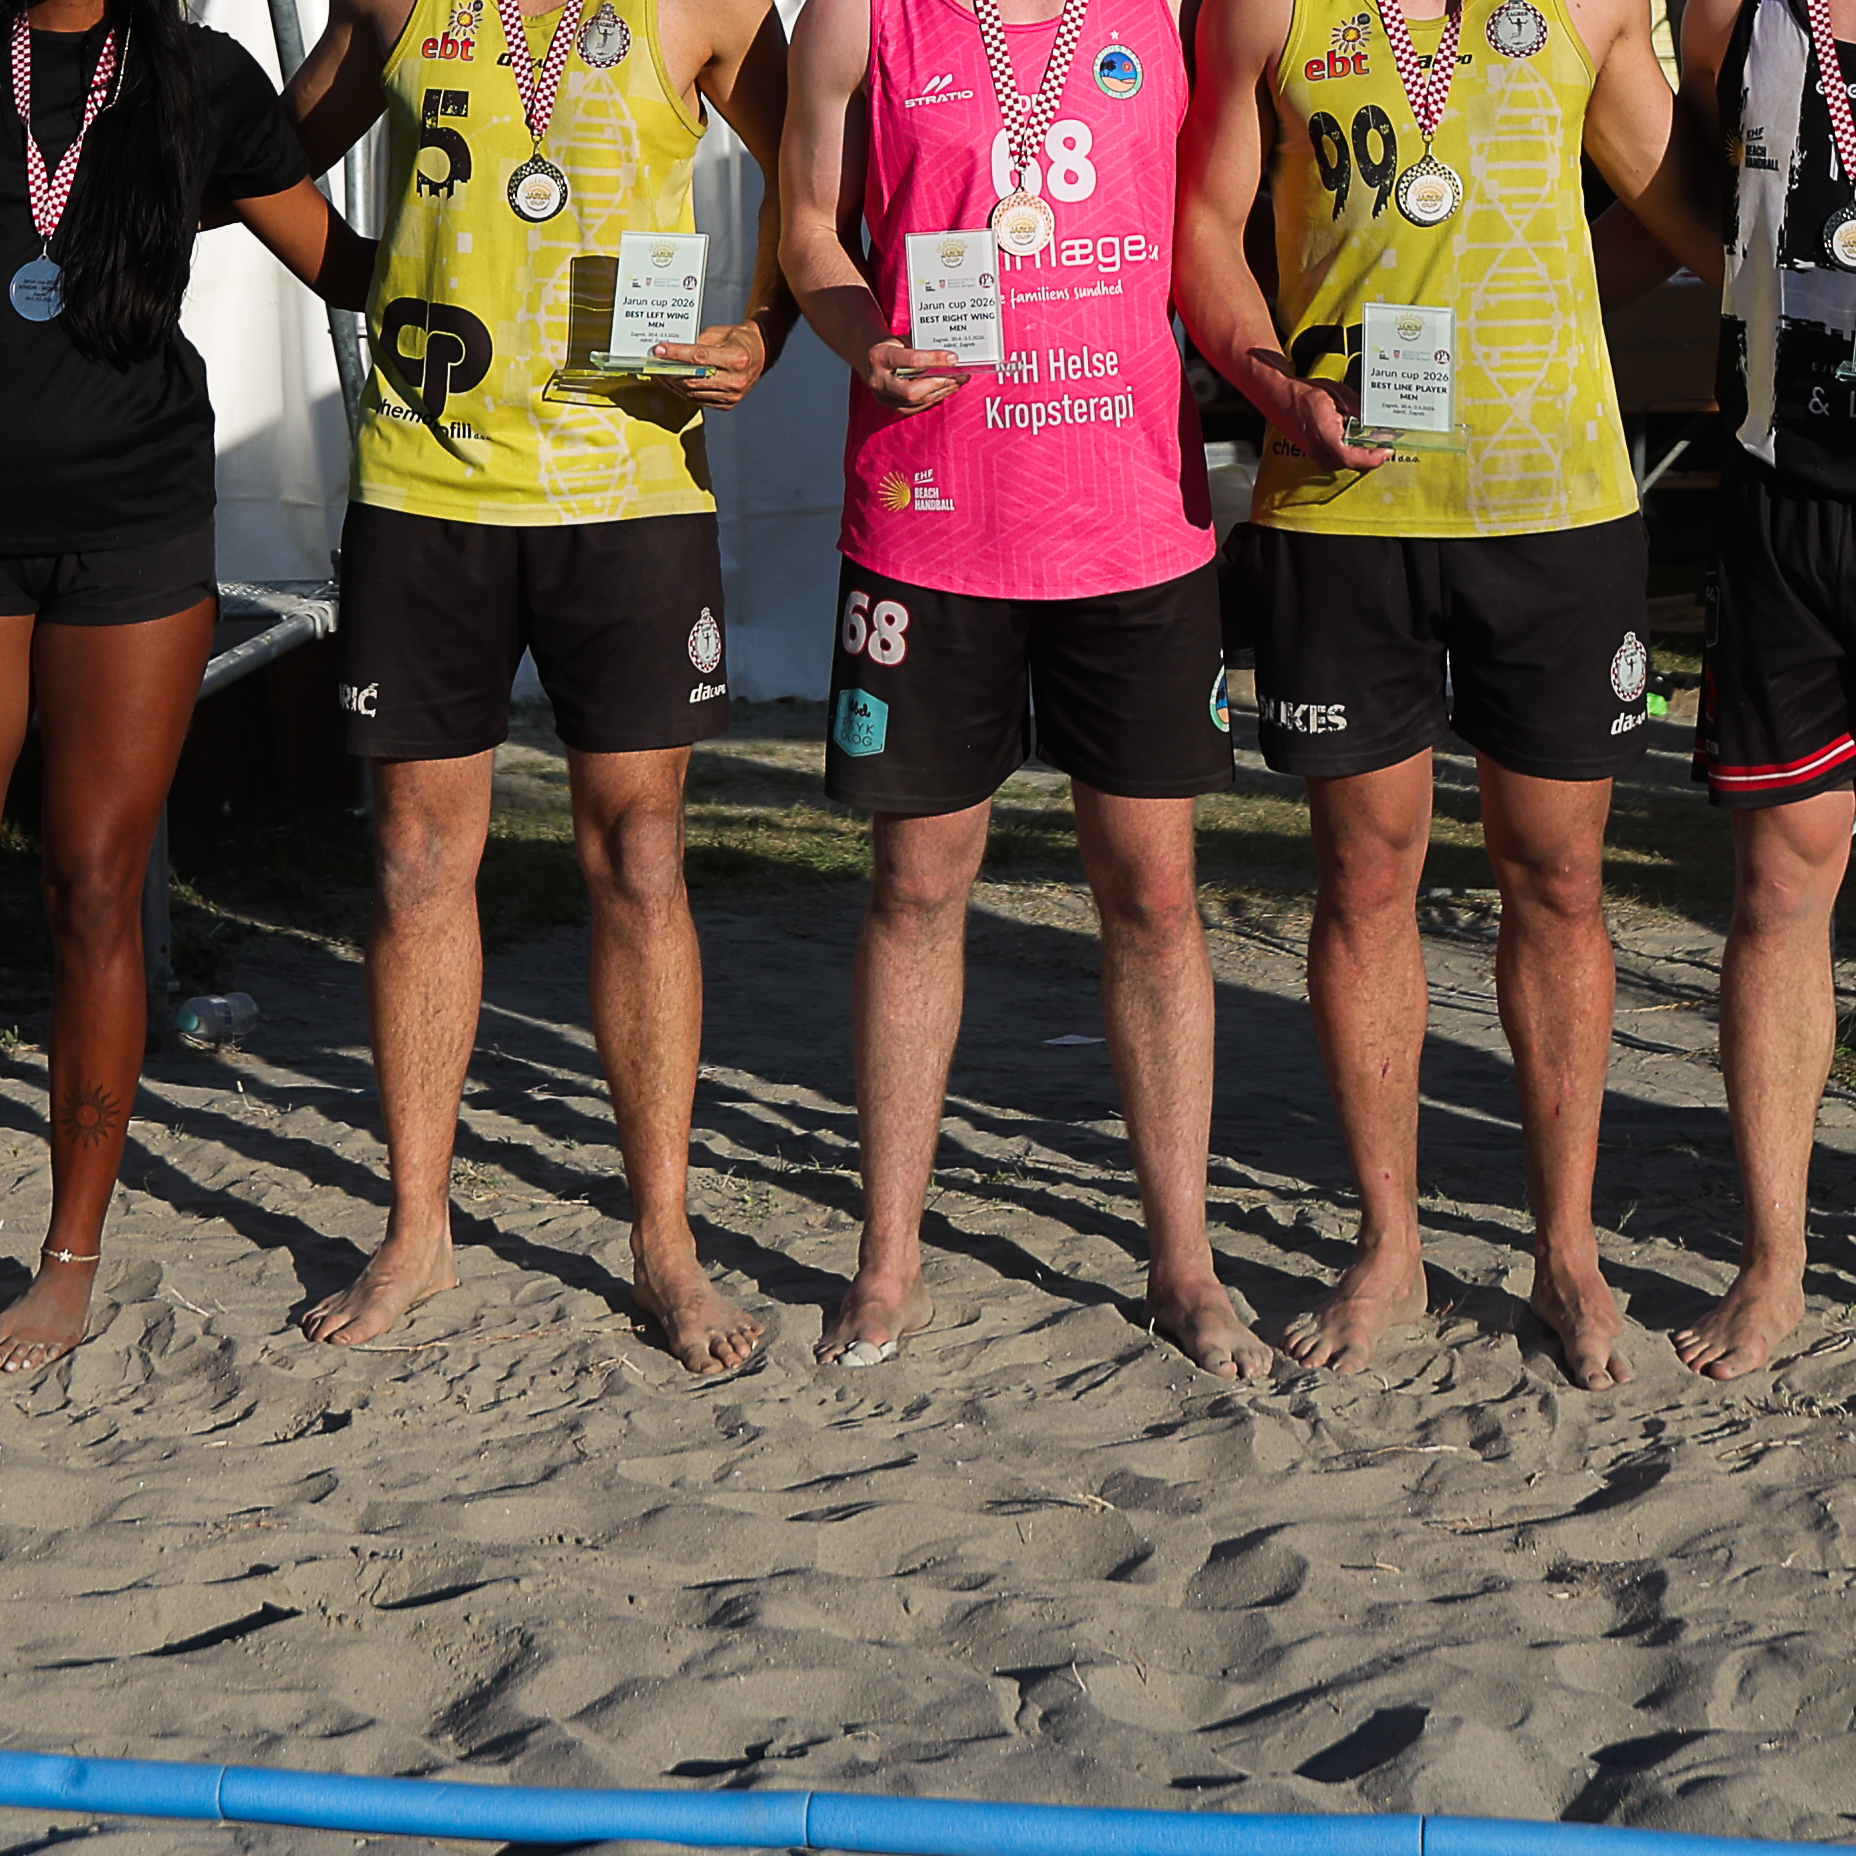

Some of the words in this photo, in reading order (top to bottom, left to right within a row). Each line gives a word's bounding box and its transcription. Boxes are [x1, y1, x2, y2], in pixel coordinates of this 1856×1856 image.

[422, 32, 475, 61] ebt
[1305, 50, 1369, 81] ebt
[905, 90, 974, 108] STRATIO
[417, 89, 472, 199] 5
[1746, 144, 1766, 156] BEACH
[991, 119, 1097, 203] 68
[1309, 105, 1397, 222] 99
[1746, 158, 1779, 171] HANDBALL
[1011, 288, 1070, 309] familiens
[1074, 280, 1123, 297] sundhed
[623, 297, 647, 305] Jarun
[651, 299, 668, 308] cup
[672, 299, 694, 307] 2026
[918, 301, 944, 311] Jarun
[949, 300, 966, 310] cup
[970, 298, 995, 307] 2026
[943, 314, 968, 322] RIGHT
[971, 312, 995, 320] WING
[996, 352, 1038, 385] MH
[1049, 345, 1119, 382] Helse
[1371, 368, 1397, 378] Jarun
[1402, 372, 1419, 380] cup
[1424, 372, 1449, 381] 2026
[1394, 383, 1413, 391] LINE
[1416, 385, 1447, 394] PLAYER
[986, 387, 1134, 435] Kropsterapi
[914, 469, 933, 481] EHF
[915, 487, 939, 499] BEACH
[914, 499, 955, 511] HANDBALL
[843, 590, 910, 668] 68
